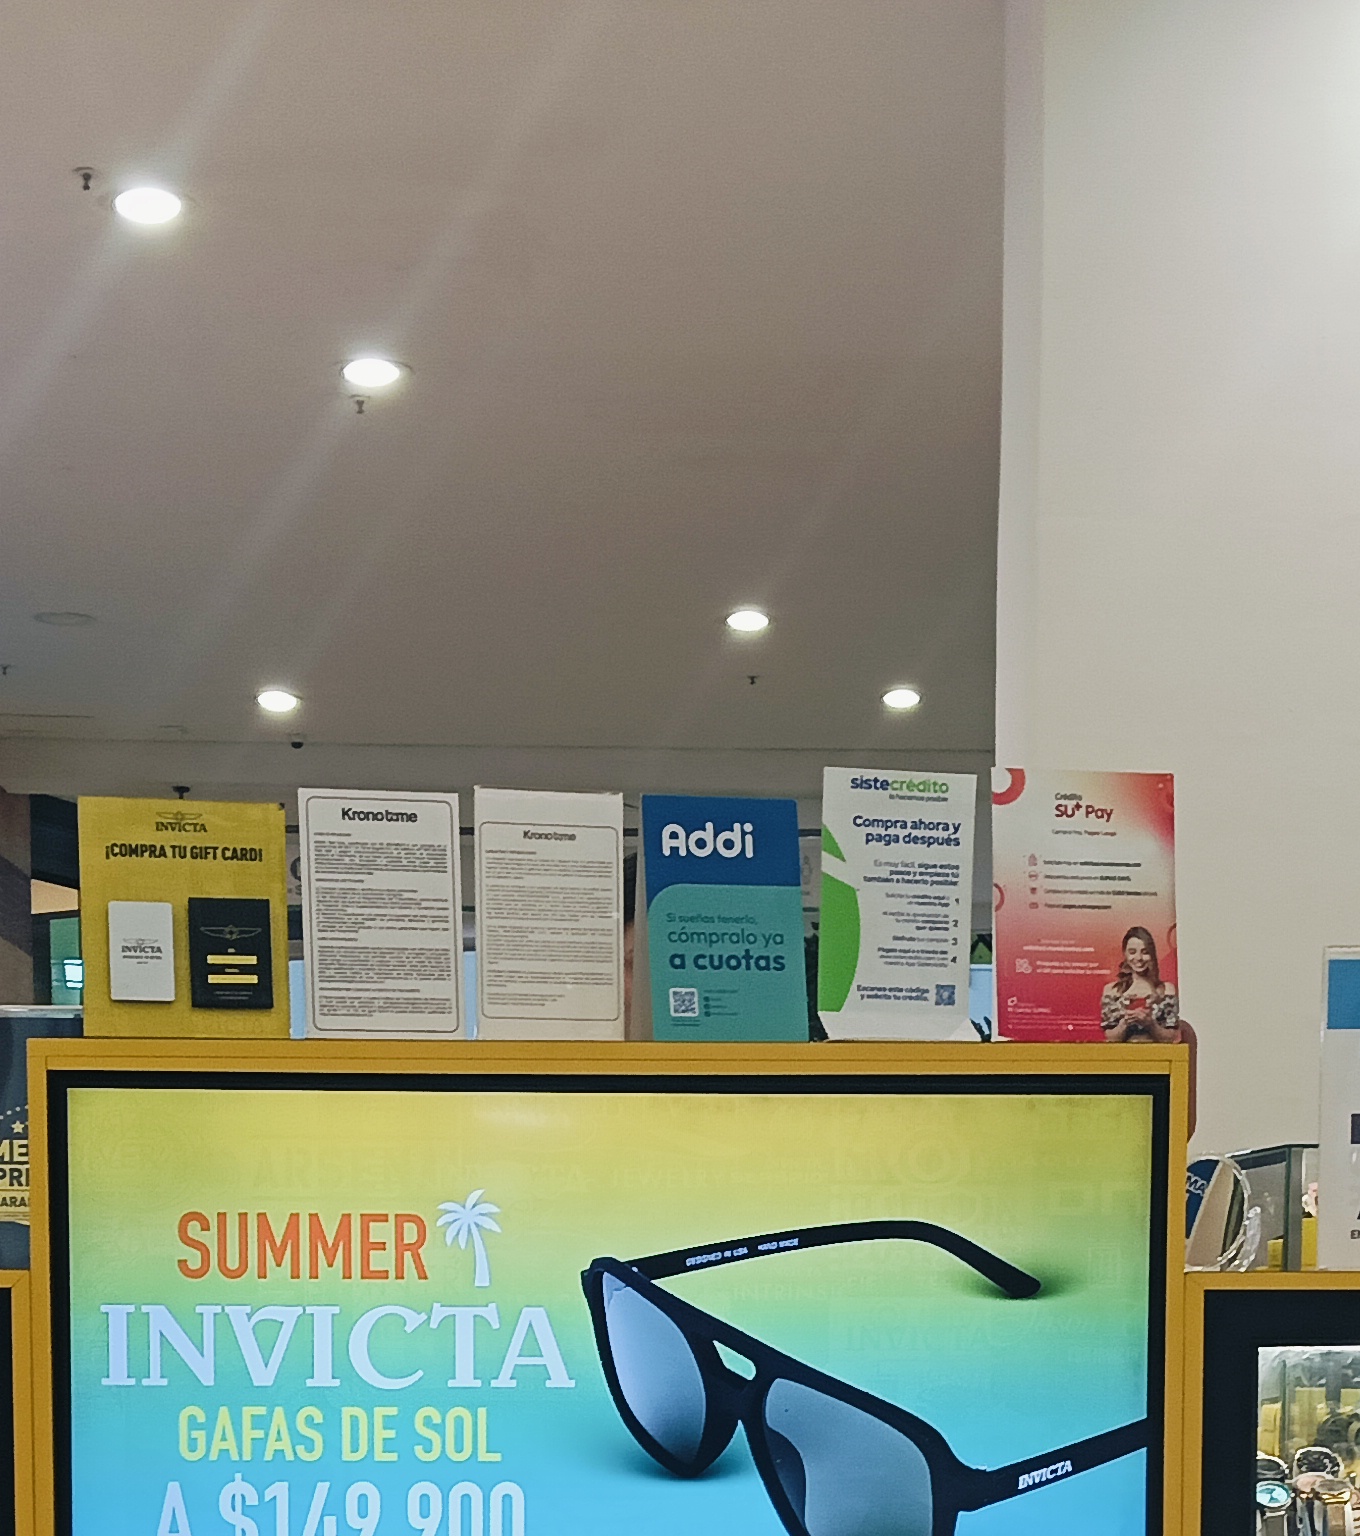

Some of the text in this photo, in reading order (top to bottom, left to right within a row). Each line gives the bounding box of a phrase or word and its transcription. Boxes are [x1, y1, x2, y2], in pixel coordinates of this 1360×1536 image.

[1085, 804, 1113, 822] Pay
[155, 821, 208, 833] INVICTA
[852, 815, 961, 836] Compra ahora y
[662, 822, 754, 859] Addi
[865, 832, 960, 848] paga después
[105, 842, 263, 862] ¡COMPRA TU GIFT CARD!
[667, 926, 784, 948] cómpralo ya
[669, 948, 786, 971] a cuotas
[177, 1211, 429, 1280] SUMMER
[100, 1302, 575, 1390] INVICTA
[178, 1406, 502, 1462] GAFAS DE SOL
[1018, 1460, 1073, 1489] INVICTA
